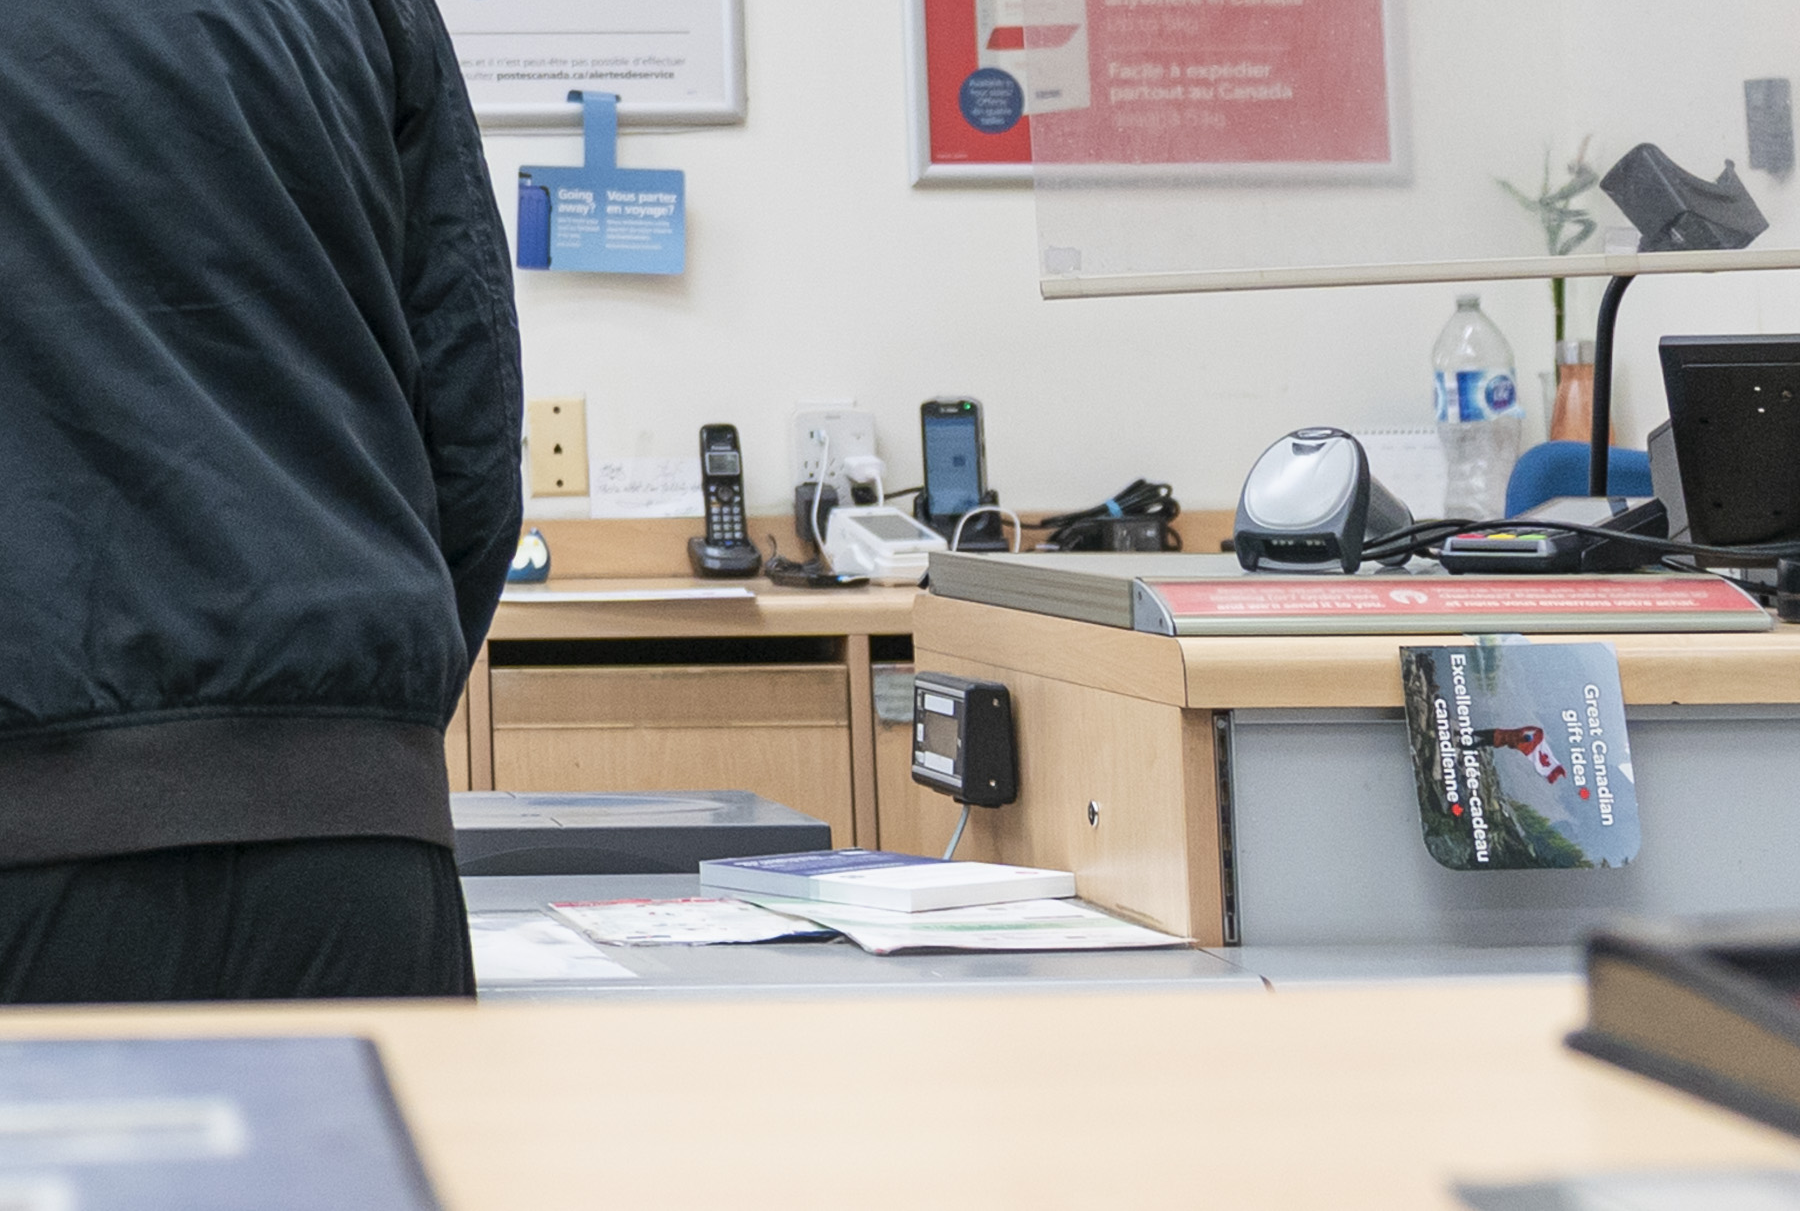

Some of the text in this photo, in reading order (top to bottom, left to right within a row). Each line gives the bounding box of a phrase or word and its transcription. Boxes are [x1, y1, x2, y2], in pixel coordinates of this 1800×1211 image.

[607, 191, 636, 203] Vous
[1450, 653, 1473, 747] Excellente
[1561, 709, 1588, 787] gift idea
[1434, 698, 1459, 804] canadienne
[1583, 683, 1615, 827] Great Canadian
[1462, 750, 1490, 864] idée-cadeau
